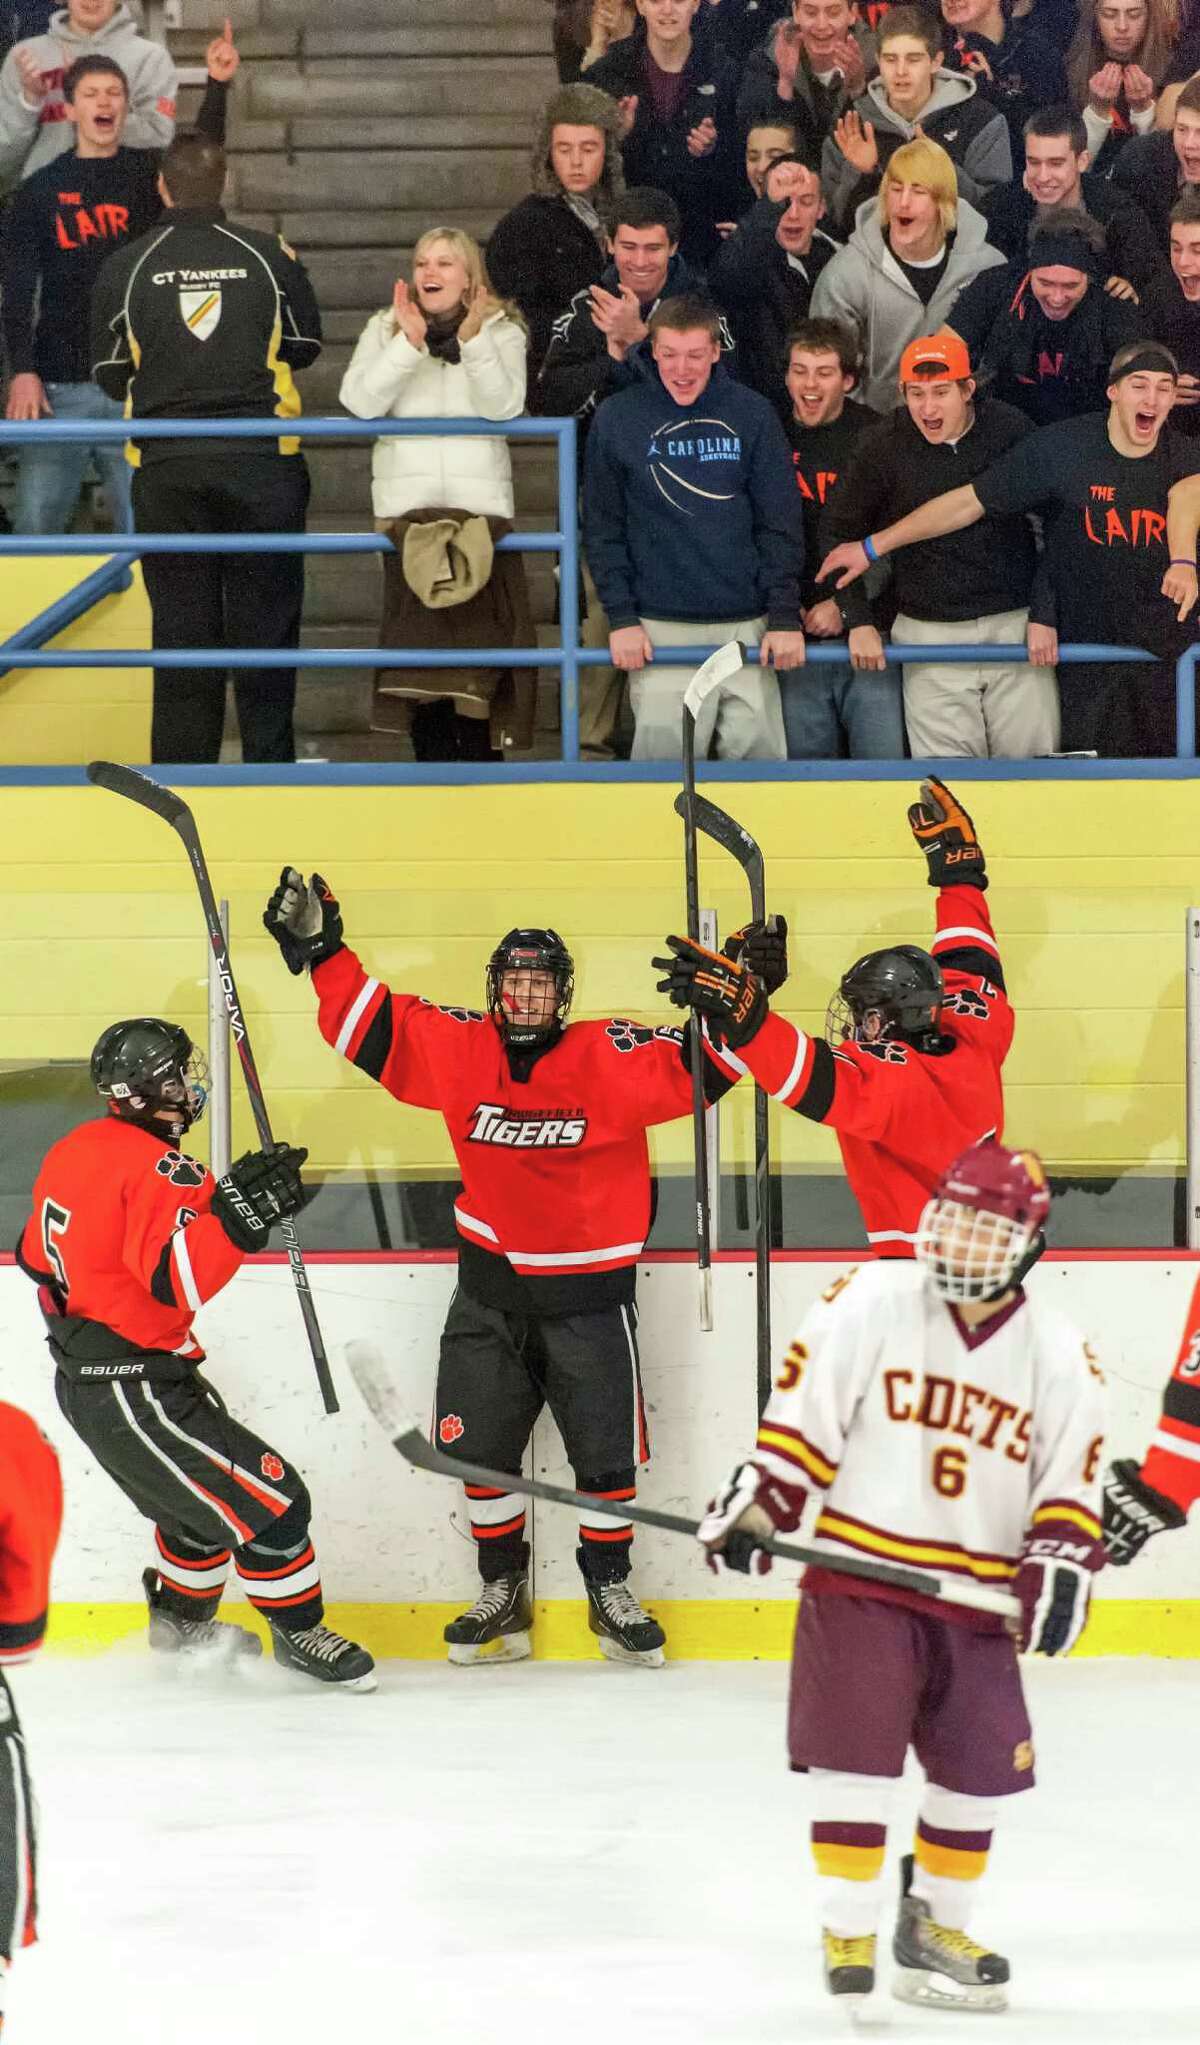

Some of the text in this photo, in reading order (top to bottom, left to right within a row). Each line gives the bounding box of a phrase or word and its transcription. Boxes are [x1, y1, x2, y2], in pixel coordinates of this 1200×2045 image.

[55, 203, 129, 250] LAIR
[152, 269, 247, 285] CT YANKEES
[668, 437, 741, 456] CAROLINA
[1089, 486, 1116, 501] THE
[1084, 505, 1166, 549] LAIR
[216, 951, 245, 1043] VAPOR
[468, 1102, 587, 1147] TIGERS
[42, 1196, 72, 1300] 5
[80, 1363, 145, 1375] BAUER
[931, 1446, 968, 1499] 6
[1023, 1538, 1092, 1562] CM
